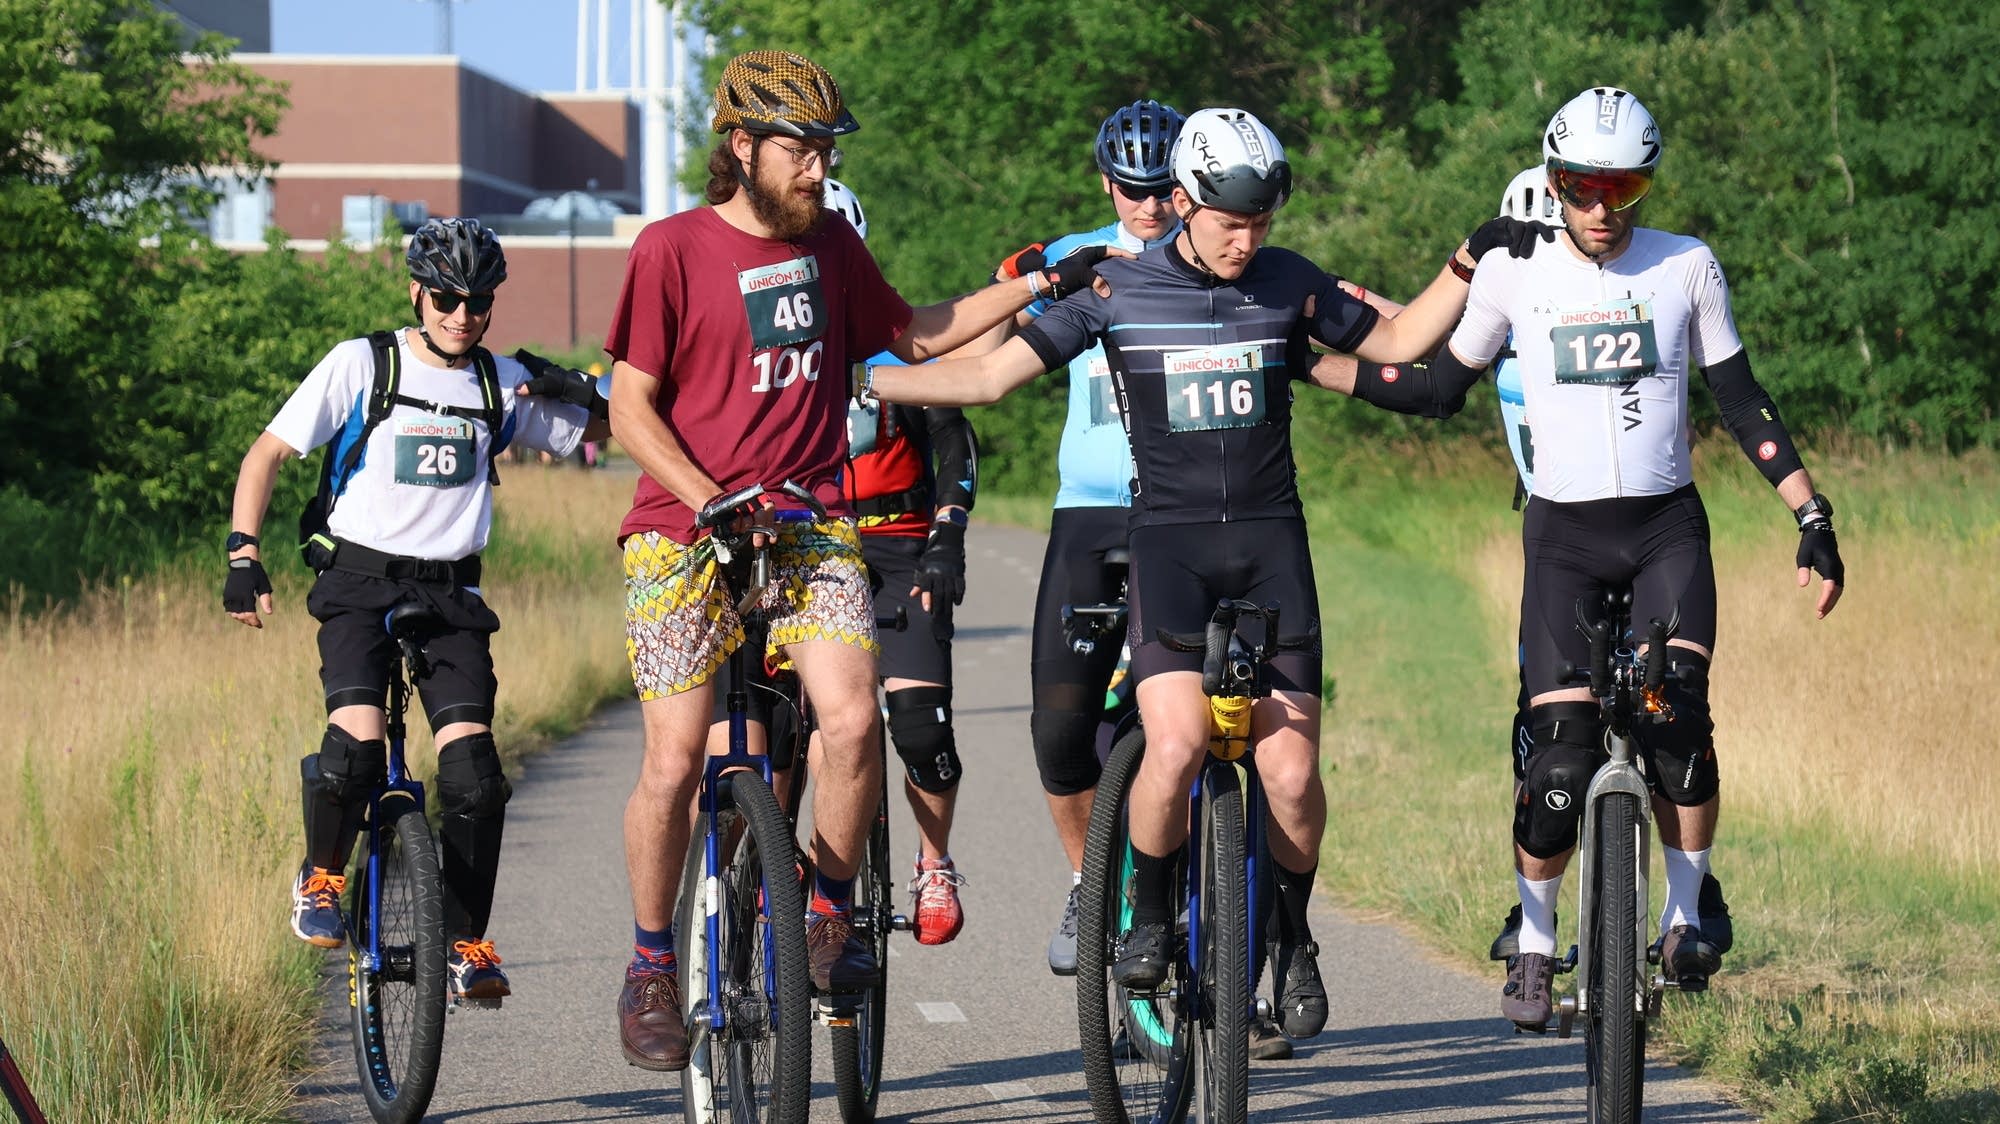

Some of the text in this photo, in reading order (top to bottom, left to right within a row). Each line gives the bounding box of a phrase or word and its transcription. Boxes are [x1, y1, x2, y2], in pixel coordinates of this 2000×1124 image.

[1600, 95, 1618, 130] AER
[1235, 122, 1268, 171] AERO
[749, 269, 805, 291] UNICON 21
[774, 291, 814, 332] 46
[1561, 310, 1611, 325] UNICON
[1614, 310, 1628, 321] 21
[1173, 358, 1223, 372] UNICON
[1226, 358, 1240, 368] 21
[1568, 331, 1643, 372] 122
[1182, 379, 1253, 418] 116
[403, 425, 457, 436] UNICON 21
[416, 444, 457, 476] 26
[1683, 753, 1697, 788] ENDURA
